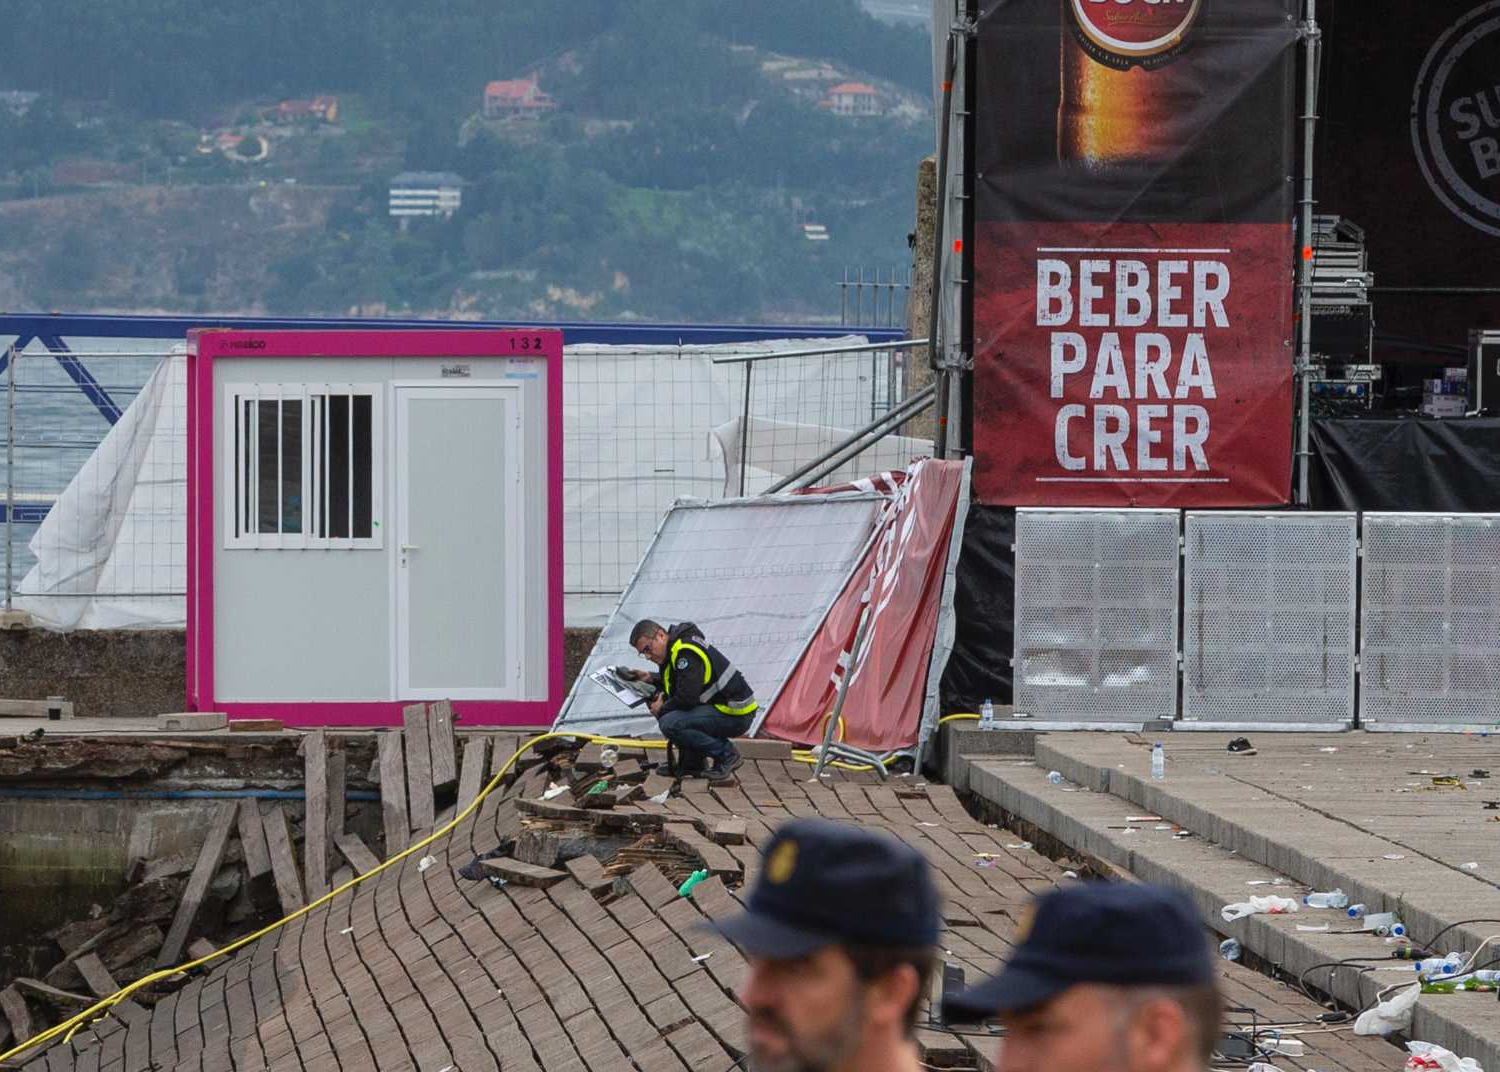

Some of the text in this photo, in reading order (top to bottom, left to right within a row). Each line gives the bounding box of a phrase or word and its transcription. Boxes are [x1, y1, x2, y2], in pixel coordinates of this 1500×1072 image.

[1036, 259, 1231, 329] BEBER
[1050, 331, 1217, 400] PARA
[1054, 404, 1211, 472] CRER
